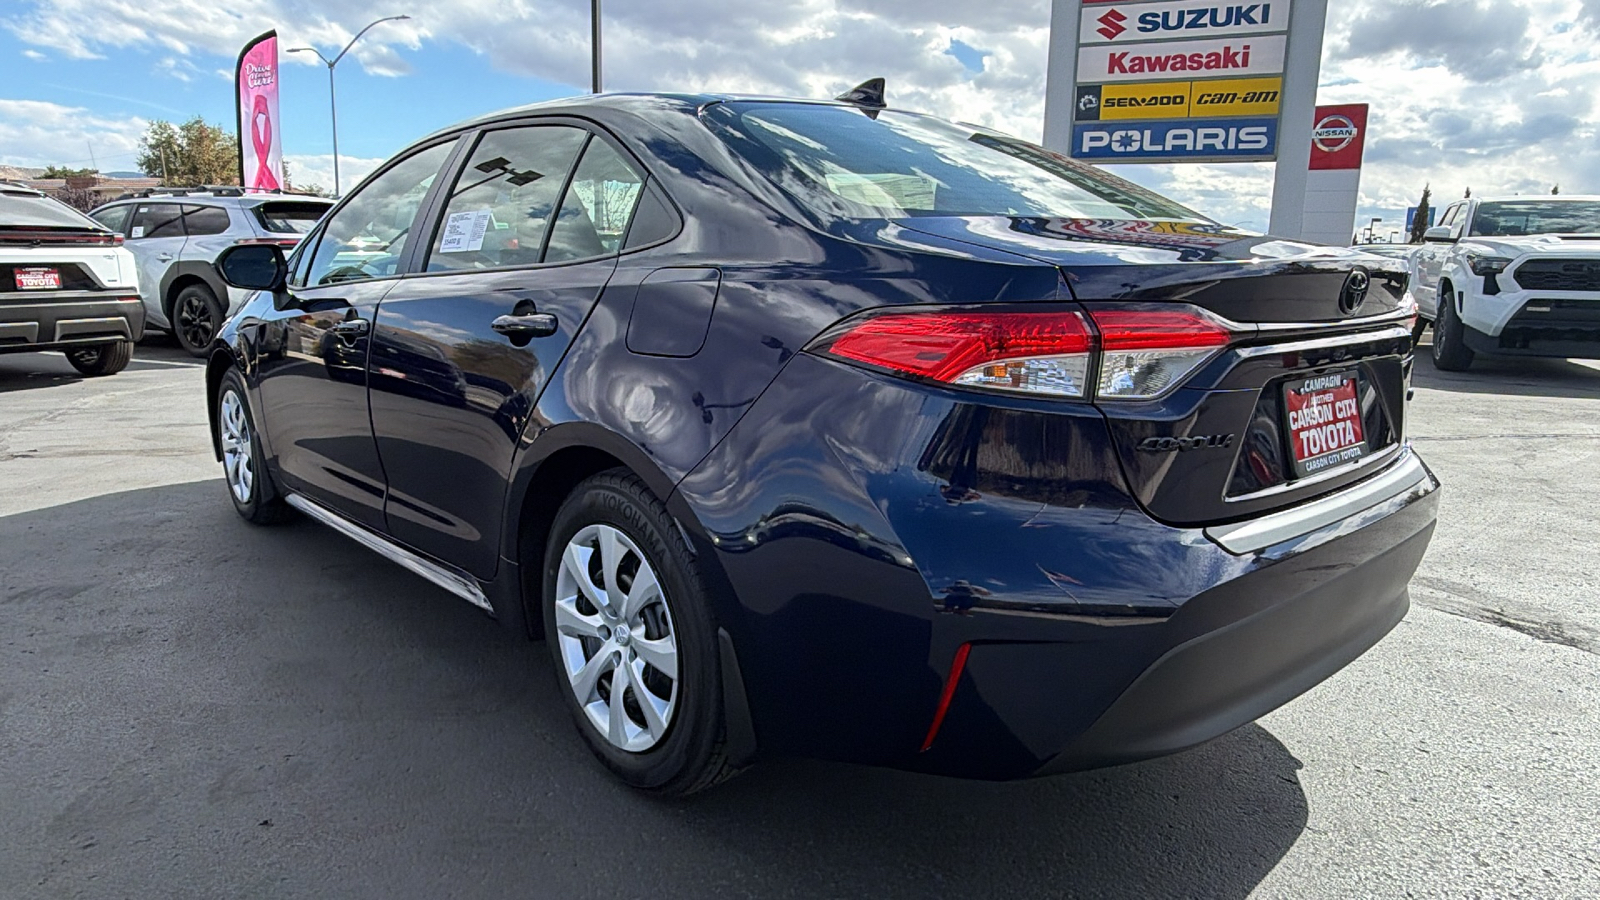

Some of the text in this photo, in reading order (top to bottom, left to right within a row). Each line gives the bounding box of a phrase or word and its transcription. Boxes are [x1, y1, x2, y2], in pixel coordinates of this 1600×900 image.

[1137, 3, 1270, 32] SUZUKI
[1107, 45, 1251, 74] Kawasaki
[1082, 126, 1269, 153] POLARIS
[1315, 129, 1353, 137] NISSAN
[1304, 375, 1341, 391] CAMPAGNI
[1289, 398, 1356, 430] CARSON CITY
[1299, 420, 1356, 458] TOYOTA
[1305, 447, 1361, 472] CARSON CITY TOYOTA
[602, 492, 667, 563] YOKOHAMA
